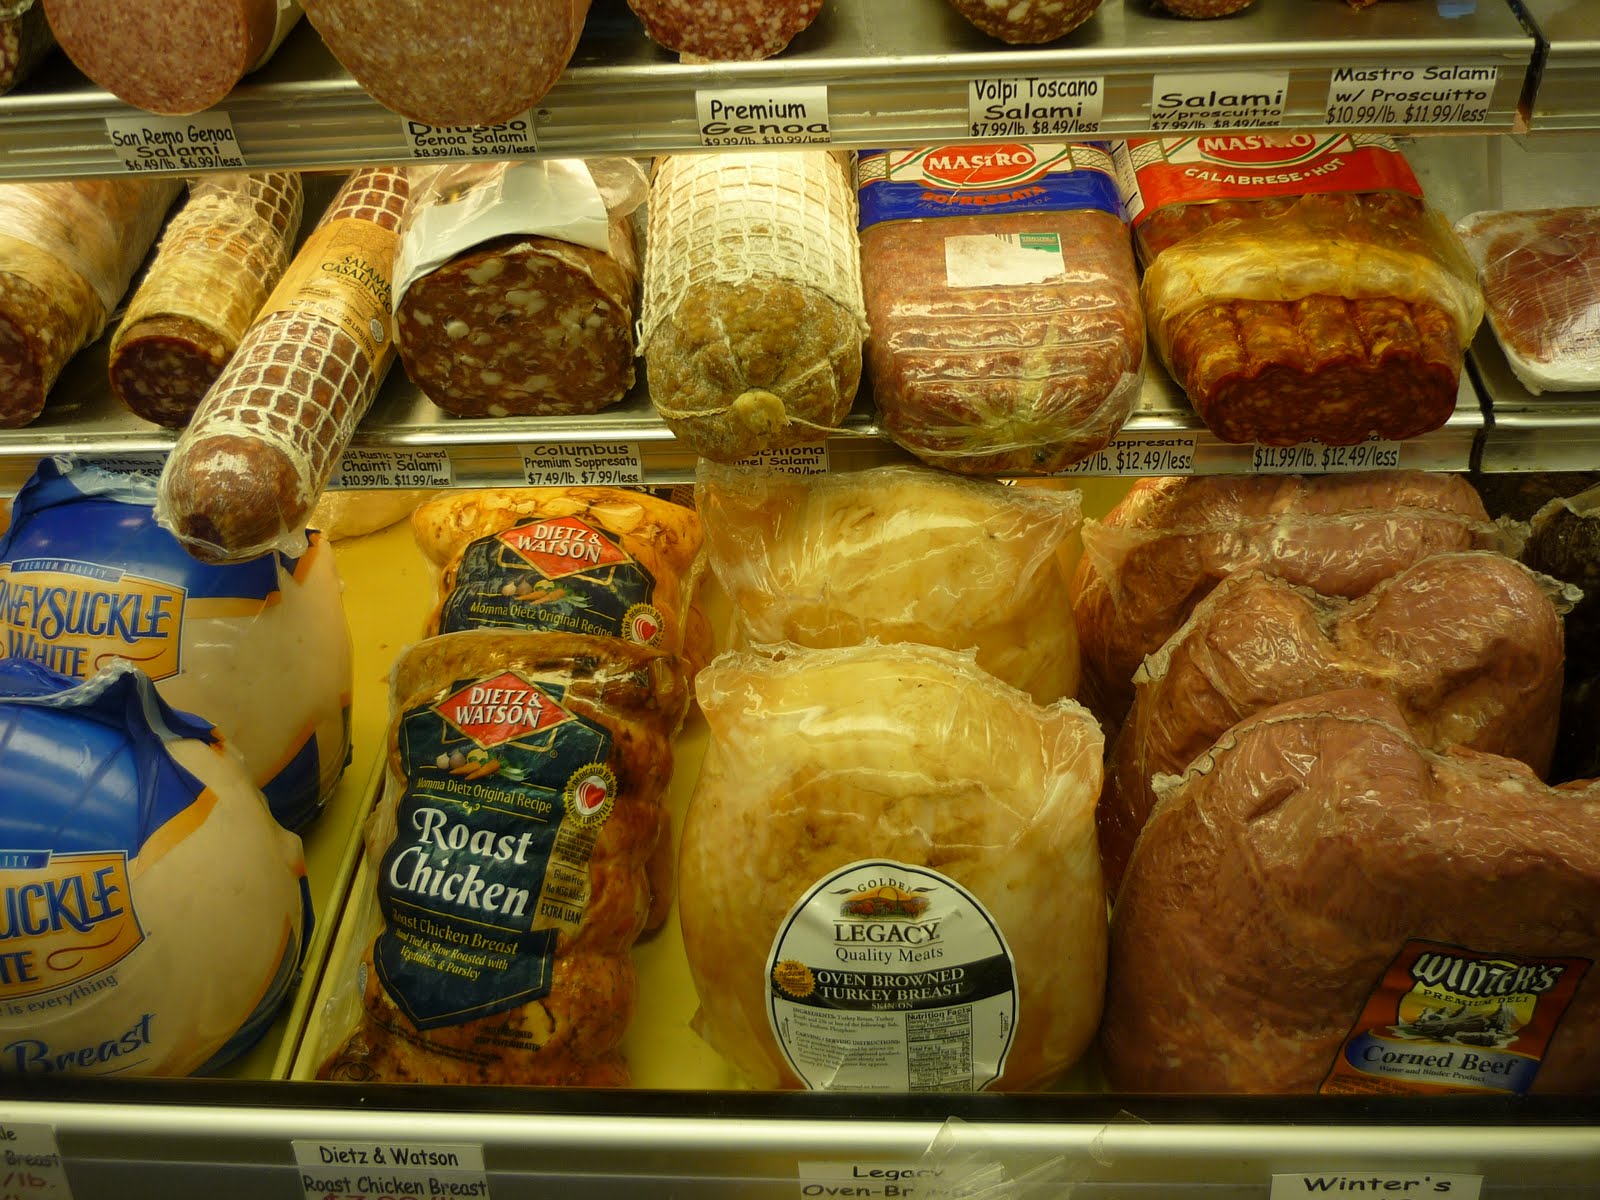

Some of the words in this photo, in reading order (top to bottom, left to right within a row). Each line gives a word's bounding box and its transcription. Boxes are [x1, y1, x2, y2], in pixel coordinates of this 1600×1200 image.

[1334, 67, 1414, 82] Mastro
[1423, 65, 1497, 80] Salami
[975, 78, 1018, 105] Volpi
[1026, 77, 1098, 98] Toscano
[1157, 90, 1283, 108] Salami
[1336, 89, 1365, 102] w/
[1371, 89, 1487, 102] Proscuitto
[711, 99, 807, 120] Premium
[984, 102, 1083, 121] Salami
[1152, 108, 1280, 121] w/proscuitto
[1326, 104, 1397, 125] $10.99/lb.
[1403, 103, 1487, 124] $11.99/less
[112, 130, 141, 147] San
[142, 128, 184, 146] Remo
[188, 125, 233, 142] Genoa
[415, 135, 466, 147] Genoa
[473, 130, 528, 144] Salami
[702, 122, 829, 136] Genoa
[971, 121, 1028, 137] $7.99/lb.
[1032, 119, 1098, 135] $8.49/less
[137, 142, 220, 159] Salami
[472, 144, 536, 155] $9.49/less
[928, 151, 1033, 171] MASTRO
[1184, 168, 1303, 185] CALABRESE
[1311, 159, 1346, 178] HOT
[342, 256, 393, 295] SALAME
[321, 262, 393, 315] CASALINGO
[534, 444, 629, 456] Columbus
[1108, 439, 1193, 449] oppresata
[342, 460, 392, 472] Chainti
[397, 459, 442, 472] Salami
[524, 457, 572, 469] Premium
[575, 456, 638, 470] Soppresata
[769, 456, 819, 466] Salami
[1116, 451, 1191, 473] $12.49/less
[1254, 447, 1317, 471] $11.99/lb.
[1321, 446, 1398, 470] $12.49/less
[341, 474, 393, 487] $10.99/lb.
[395, 474, 449, 486] $11.99/less
[528, 472, 579, 485] $7.49/lb.
[581, 471, 638, 484] $7.99/less
[534, 524, 588, 542] DIETZ
[589, 532, 602, 546] &
[518, 535, 602, 564] WATSON
[20, 561, 58, 571] PREMIUM
[63, 562, 107, 579] QUALITY
[470, 602, 508, 616] Momma
[510, 604, 536, 620] Dietz
[538, 609, 580, 628] Original
[8, 629, 87, 677] WHITE
[470, 687, 529, 706] DIETZ
[528, 693, 543, 708] &
[455, 705, 543, 728] WATSON
[416, 777, 445, 791] Momma
[447, 779, 472, 796] Dietz
[474, 785, 517, 806] Original
[519, 793, 552, 814] Recipe
[412, 807, 533, 865] Roast
[390, 846, 530, 917] Chicken
[541, 903, 563, 919] EXTRA
[564, 909, 582, 925] LEAN
[392, 908, 418, 930] Roast
[420, 919, 472, 945] Chicken
[471, 933, 519, 955] Breast
[834, 922, 940, 944] LEGACY
[400, 945, 436, 968] Vegetables
[446, 962, 481, 981] Parsley
[431, 943, 451, 957] Slow
[450, 949, 487, 966] Roasted
[488, 959, 508, 970] with
[836, 947, 892, 965] Quality
[899, 947, 943, 962] Meats
[817, 971, 868, 986] OVEN
[872, 967, 964, 987] BROWNED
[1412, 953, 1564, 994] WINTER'S
[9, 1003, 23, 1016] is
[28, 974, 118, 1012] everything
[820, 986, 891, 1001] TURKEY
[897, 982, 964, 1000] BREAST
[1423, 989, 1493, 1006] PREMIUM
[1497, 995, 1528, 1004] DELI
[907, 1012, 945, 1020] Nutrition
[947, 1007, 971, 1016] Facts
[3, 1012, 157, 1073] Breast
[1363, 1045, 1454, 1068] Corned
[1458, 1054, 1518, 1075] Beef
[1405, 1067, 1421, 1075] and
[1422, 1068, 1452, 1078] Binder
[1452, 1071, 1486, 1082] Product
[319, 1146, 369, 1164] Dietz
[373, 1147, 386, 1164] &
[390, 1148, 458, 1166] Watson
[303, 1175, 351, 1193] Roast
[358, 1176, 424, 1195] Chicken
[429, 1178, 486, 1197] Breast
[1304, 1177, 1451, 1192] Winter's
